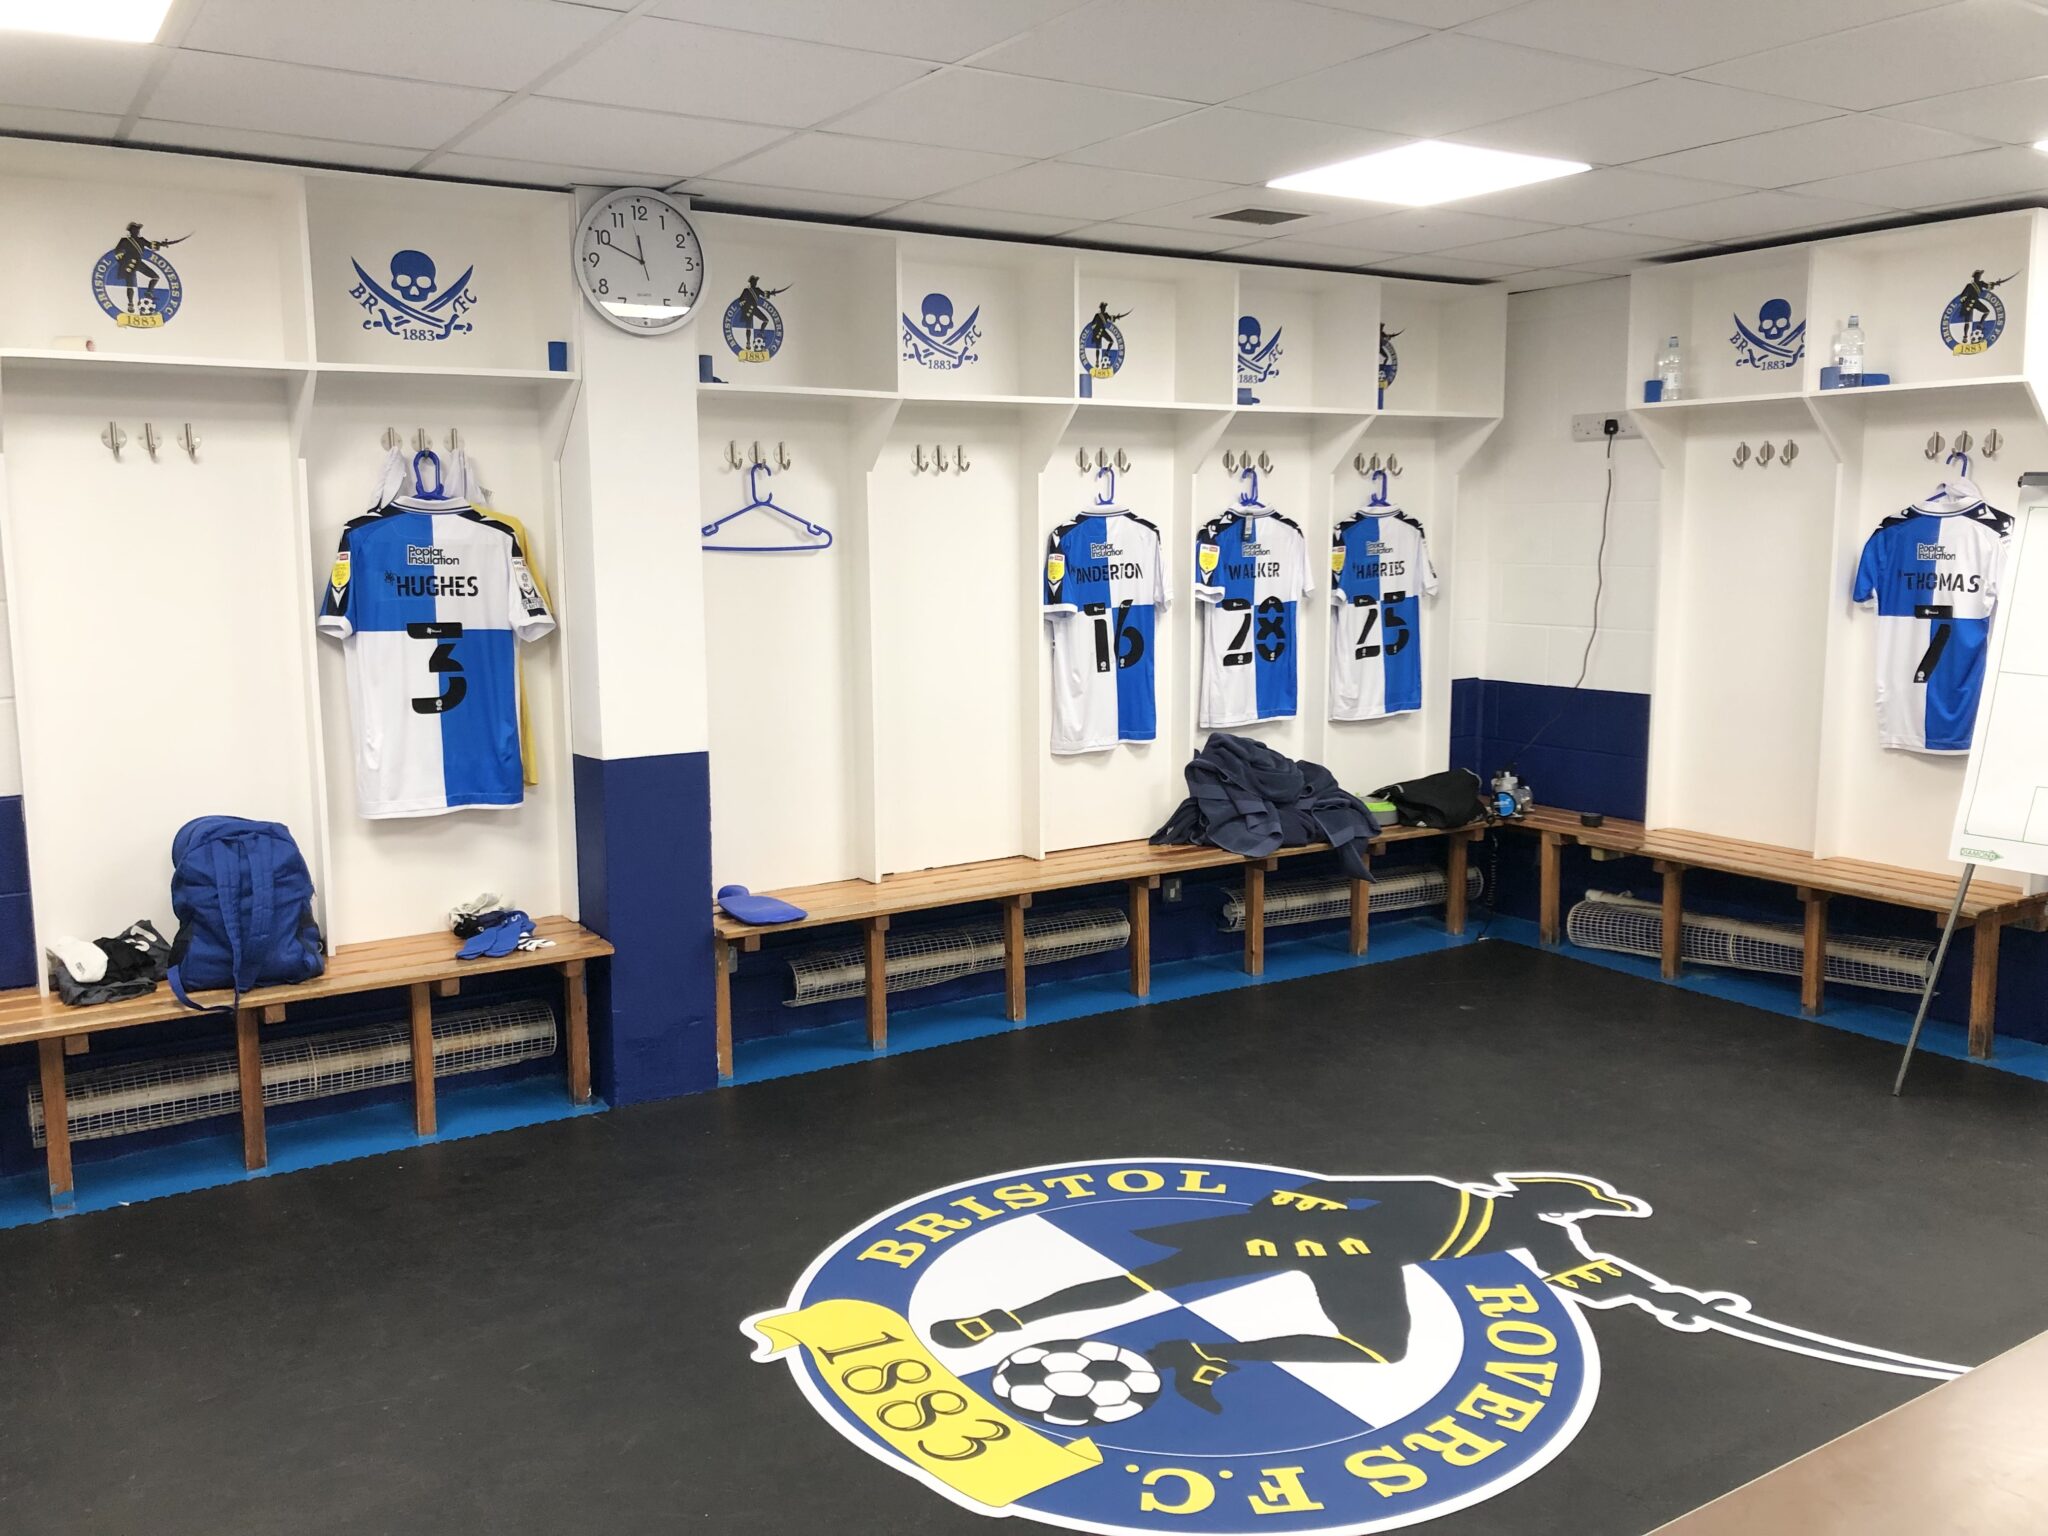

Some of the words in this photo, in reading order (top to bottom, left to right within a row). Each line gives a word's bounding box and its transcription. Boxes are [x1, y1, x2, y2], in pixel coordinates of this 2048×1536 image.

[611, 213, 624, 228] 11
[631, 205, 648, 221] 12
[659, 215, 665, 230] 1
[595, 229, 611, 245] 10
[675, 234, 686, 249] 2
[588, 252, 600, 268] 9
[684, 257, 694, 272] 3
[94, 259, 113, 310] BRISTOL
[149, 253, 180, 298] ROVERS
[165, 301, 178, 316] FC
[598, 278, 609, 295] 8
[677, 281, 688, 297] 4
[127, 315, 157, 327] 1883
[402, 328, 436, 342] 1883
[928, 359, 952, 370] 1883
[1761, 360, 1786, 371] 1883
[1239, 374, 1258, 384] 1883
[408, 545, 444, 557] Poplar
[1918, 543, 1946, 553] Poplar
[1918, 551, 1956, 561] Insulation
[408, 555, 460, 565] Insulation
[1229, 562, 1280, 581] WALKER
[396, 575, 479, 597] HUGHES
[1903, 573, 1981, 594] THOMAS
[1353, 590, 1409, 660] 25
[1084, 599, 1144, 673] 16
[1914, 605, 1953, 683] 7
[407, 622, 468, 714] 3
[857, 1170, 1227, 1269] BRISTOL
[1344, 1282, 1559, 1498] ROVERS
[817, 1331, 1011, 1461] 1883
